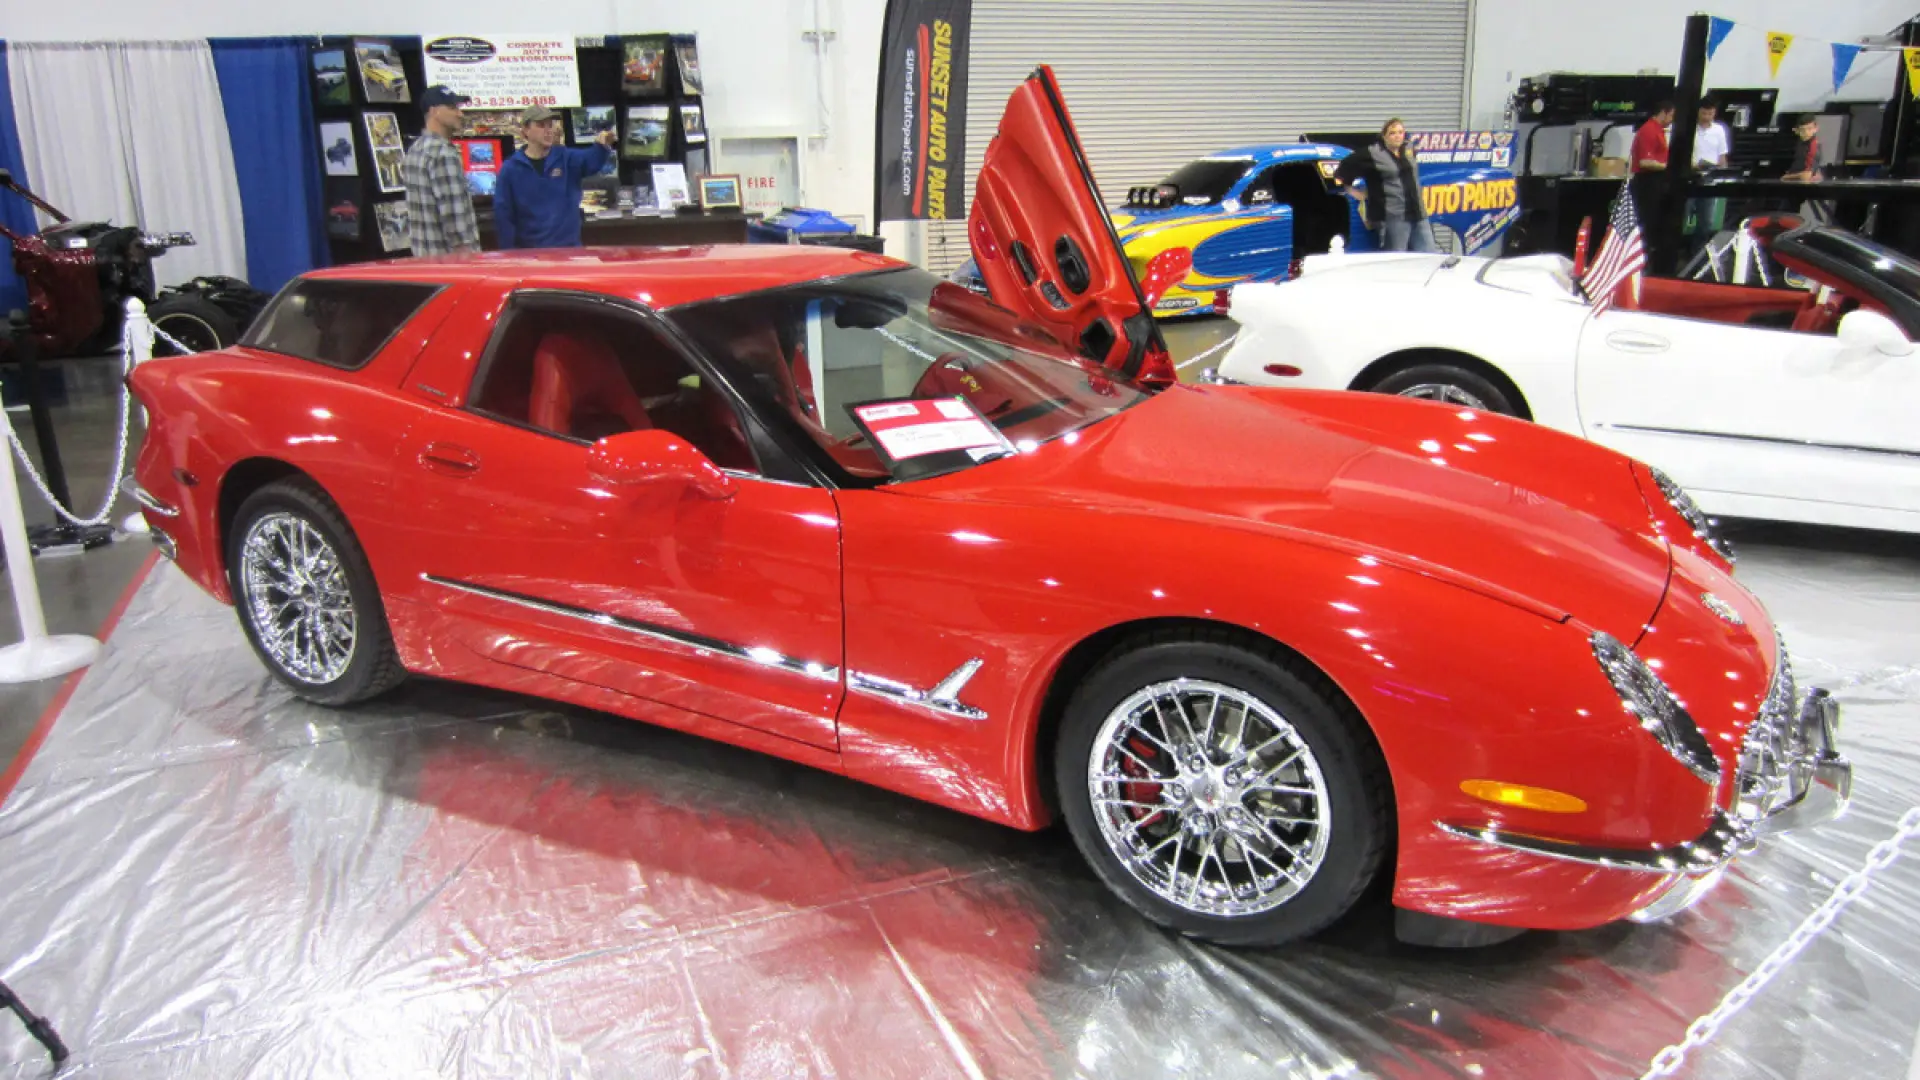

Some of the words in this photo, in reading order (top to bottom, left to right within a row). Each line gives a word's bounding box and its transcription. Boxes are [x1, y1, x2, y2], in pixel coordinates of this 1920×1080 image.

[498, 55, 574, 63] RESTORATION
[931, 19, 952, 112] SUNSET
[902, 48, 915, 196] sunsetautoparts.com
[929, 110, 946, 162] AUTO
[1410, 132, 1478, 150] CARLYLE
[746, 176, 776, 189] FIRE
[927, 165, 946, 220] PARTS
[1462, 179, 1516, 211] PARTS
